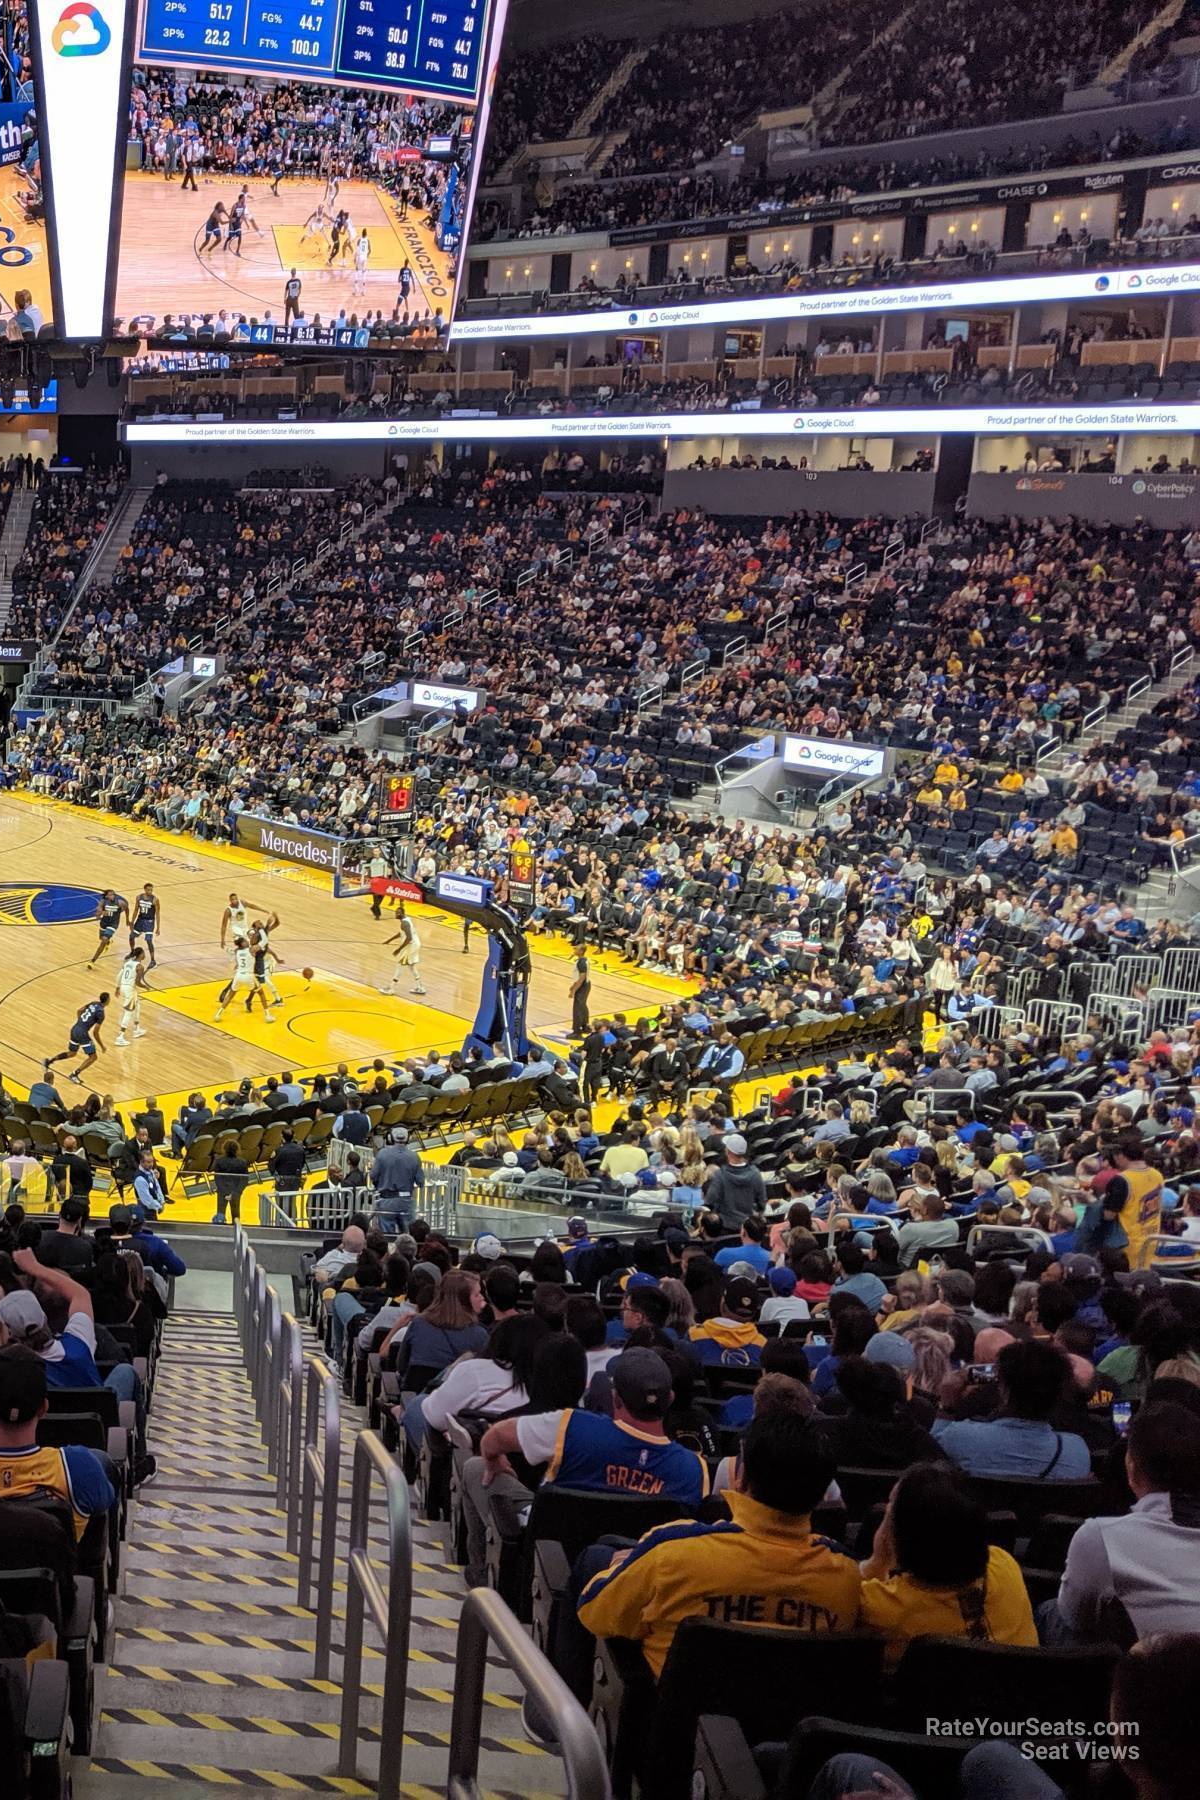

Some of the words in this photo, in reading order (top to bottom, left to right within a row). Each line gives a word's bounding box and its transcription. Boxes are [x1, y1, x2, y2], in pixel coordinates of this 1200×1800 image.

[165, 2, 186, 13] 2P%
[210, 3, 232, 20] 51.7
[360, 1, 374, 12] STL
[405, 7, 411, 20] 1
[262, 12, 282, 24] FG%
[300, 14, 322, 31] 44.7
[432, 13, 447, 24] PITP
[464, 18, 474, 32] 20
[163, 27, 185, 39] 3P%
[204, 29, 230, 46] 22.2
[357, 26, 374, 37] 2P%
[388, 27, 408, 44] 50.0
[259, 38, 278, 49] FT%
[291, 38, 319, 57] 100.0
[428, 37, 444, 48] FG%
[454, 41, 471, 56] 44.7
[354, 50, 371, 61] 3P%
[386, 52, 405, 69] 38.9
[426, 61, 440, 72] FT%
[452, 62, 468, 79] 75.0
[1085, 174, 1124, 189] Rakuten
[998, 185, 1035, 199] CHASE
[400, 221, 448, 297] FRANCISCO
[1146, 273, 1179, 286] Google
[800, 302, 820, 310] Proud
[821, 301, 847, 310] partner
[858, 298, 870, 306] the
[871, 296, 898, 306] Golden
[899, 295, 919, 304] State
[660, 312, 682, 322] Google
[683, 311, 700, 320] Cloud
[255, 328, 268, 341] 44
[297, 328, 315, 339] 6:13
[453, 326, 462, 334] the
[463, 326, 486, 334] Golden
[340, 332, 352, 344] 47
[807, 418, 832, 429] Google
[834, 417, 854, 427] Cloud
[987, 415, 1012, 425] Proud
[1013, 416, 1044, 426] partner
[1047, 414, 1058, 424] of
[1059, 414, 1074, 424] the
[1075, 414, 1109, 424] Golden
[1110, 414, 1134, 424] State
[1136, 412, 1178, 424] Warriors.
[400, 426, 420, 434] Google
[422, 425, 438, 434] Cloud
[552, 424, 568, 432] Proud
[568, 424, 589, 432] partner
[590, 422, 596, 430] of
[598, 422, 607, 430] the
[608, 422, 628, 430] Golden
[630, 422, 644, 430] State
[805, 472, 818, 481] 103
[1108, 476, 1123, 485] 104
[1147, 482, 1194, 494] CyberPolicy
[432, 692, 452, 704] Google
[814, 750, 844, 764] Google
[390, 778, 412, 790] 6:12
[392, 790, 408, 810] 19
[85, 835, 134, 852] CHASE
[148, 855, 204, 873] CENTER
[516, 857, 531, 867] 6:12
[518, 867, 528, 880] 19
[240, 958, 246, 968] 3
[124, 970, 130, 980] 0
[606, 1464, 665, 1496] GREEN
[703, 1594, 767, 1623] THE
[776, 1595, 839, 1632] CITY
